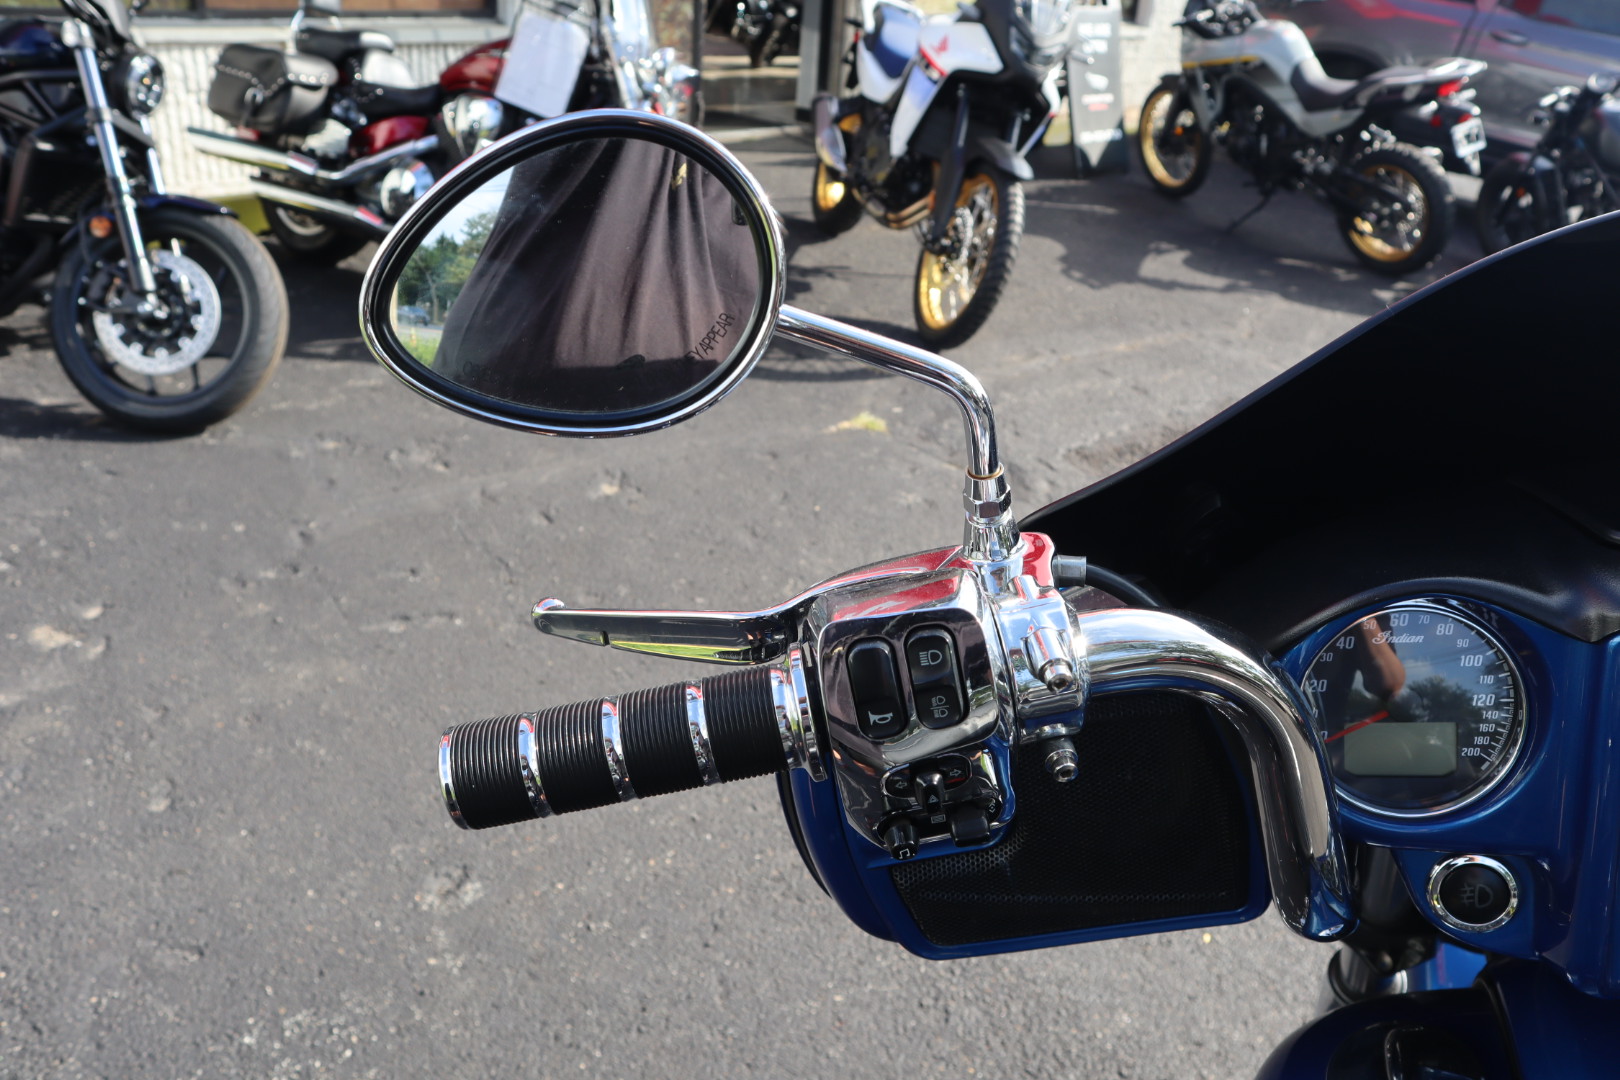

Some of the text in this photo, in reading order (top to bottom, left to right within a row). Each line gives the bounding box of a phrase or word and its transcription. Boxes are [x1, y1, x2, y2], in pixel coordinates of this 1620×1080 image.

[699, 312, 735, 355] APPEAR
[1390, 613, 1409, 627] 60
[1418, 615, 1430, 624] 70
[1363, 621, 1377, 630] 50
[1436, 623, 1454, 636] 80
[1372, 630, 1424, 645] Indian
[1336, 636, 1355, 650] 40
[1457, 639, 1470, 648] 90
[1320, 652, 1333, 662] 30
[1460, 655, 1483, 667] 100
[1480, 675, 1494, 684] 110
[1309, 679, 1327, 693] 20
[1472, 694, 1495, 706] 120
[1482, 711, 1499, 720] 140
[1479, 723, 1495, 732] 160
[1474, 736, 1490, 745] 180
[1461, 748, 1480, 757] 200
